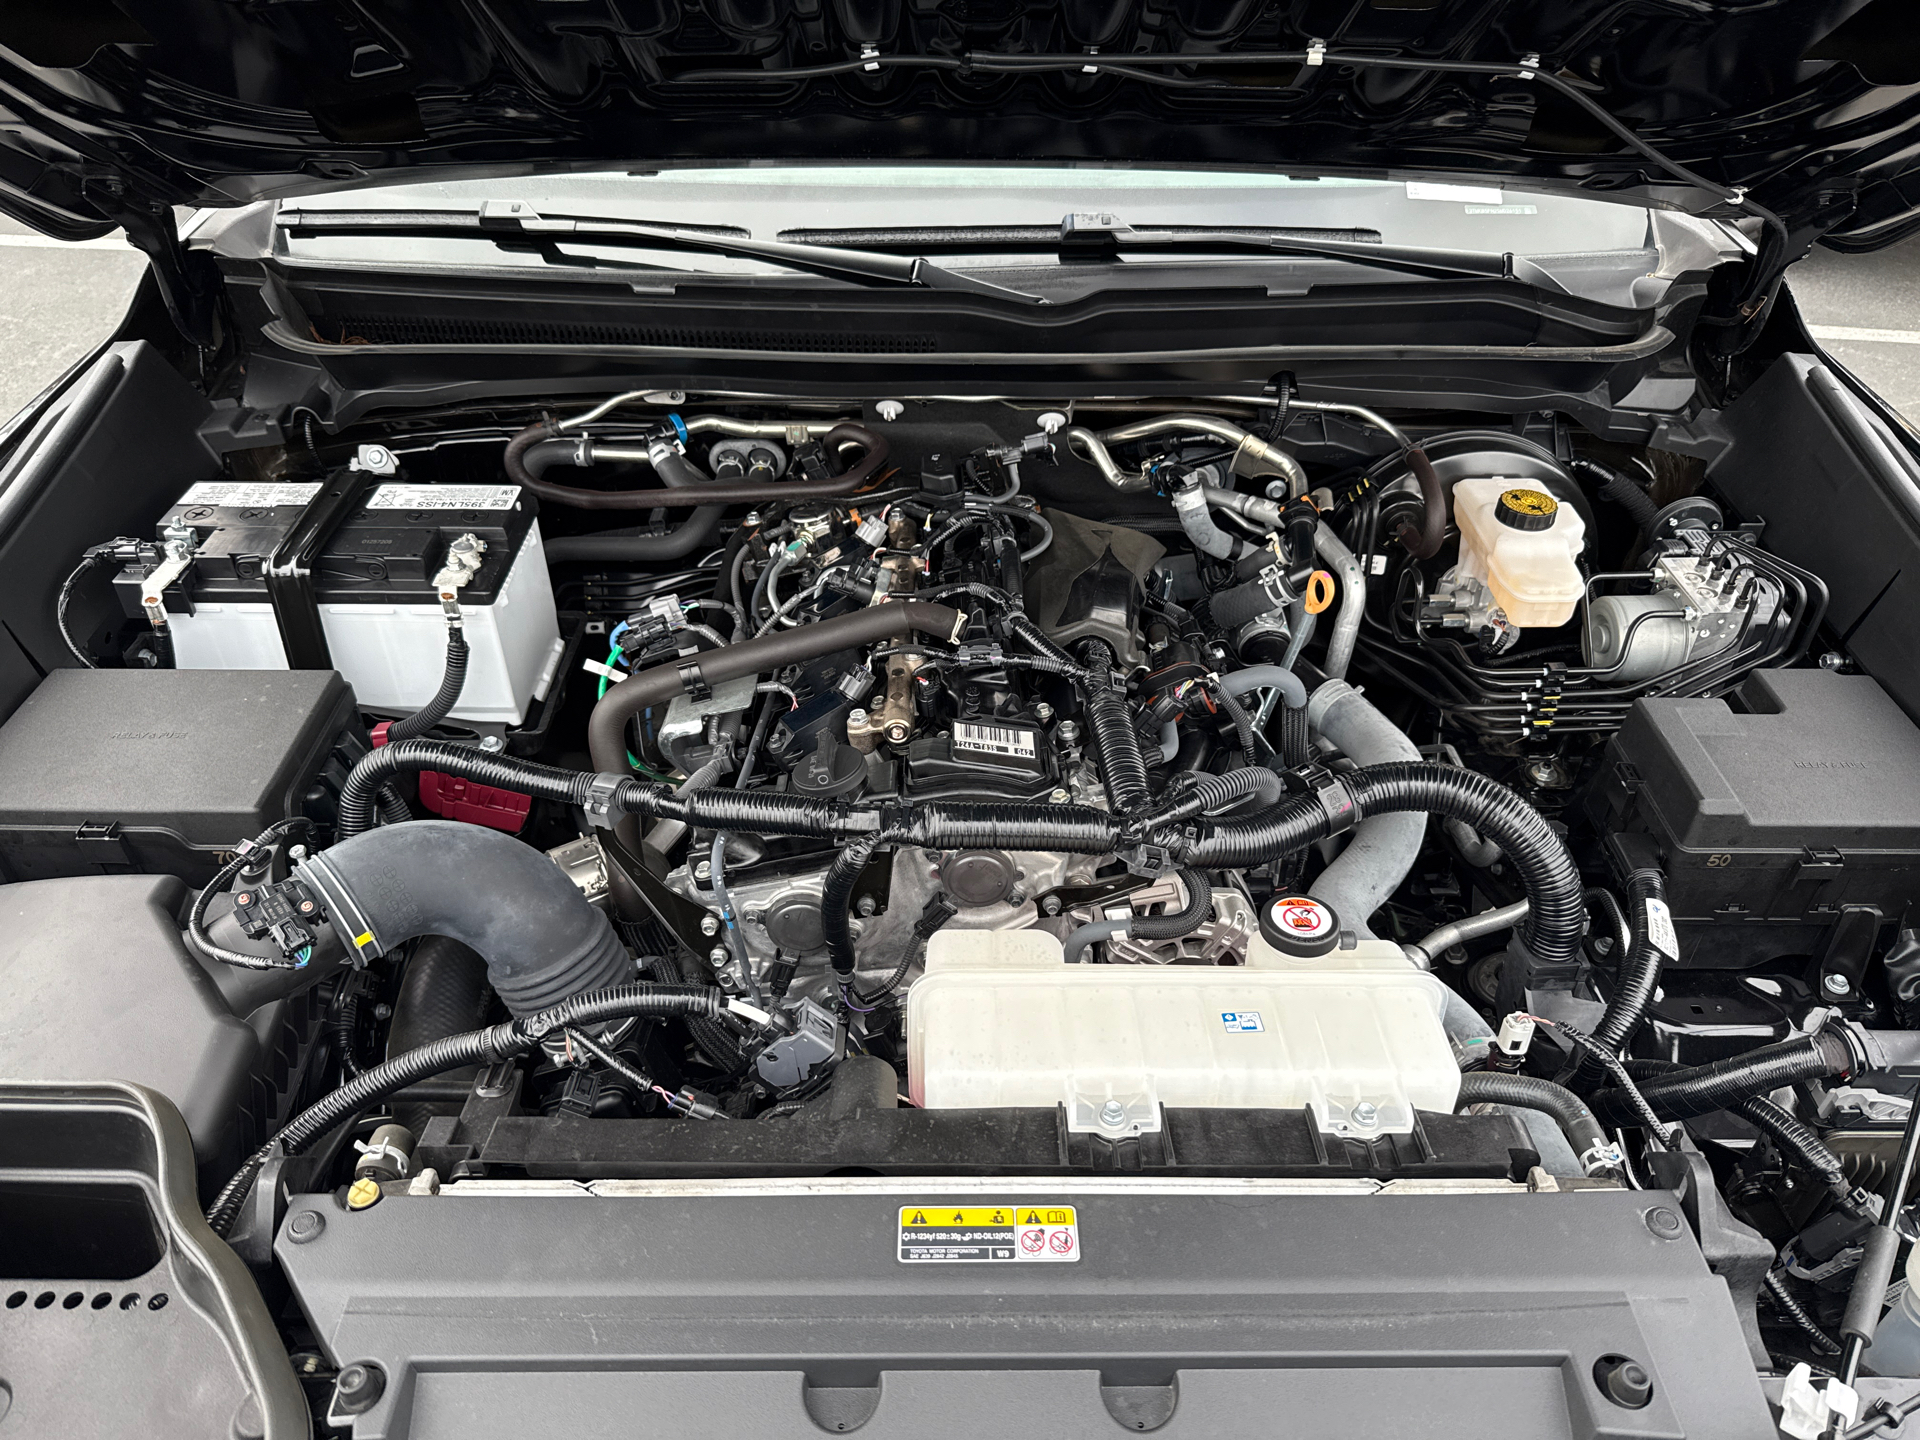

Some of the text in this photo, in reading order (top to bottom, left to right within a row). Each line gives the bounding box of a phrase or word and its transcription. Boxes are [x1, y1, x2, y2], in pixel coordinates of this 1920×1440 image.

[1706, 854, 1731, 867] 50
[910, 1232, 936, 1242] R-1234yf
[996, 1249, 1010, 1258] W9
